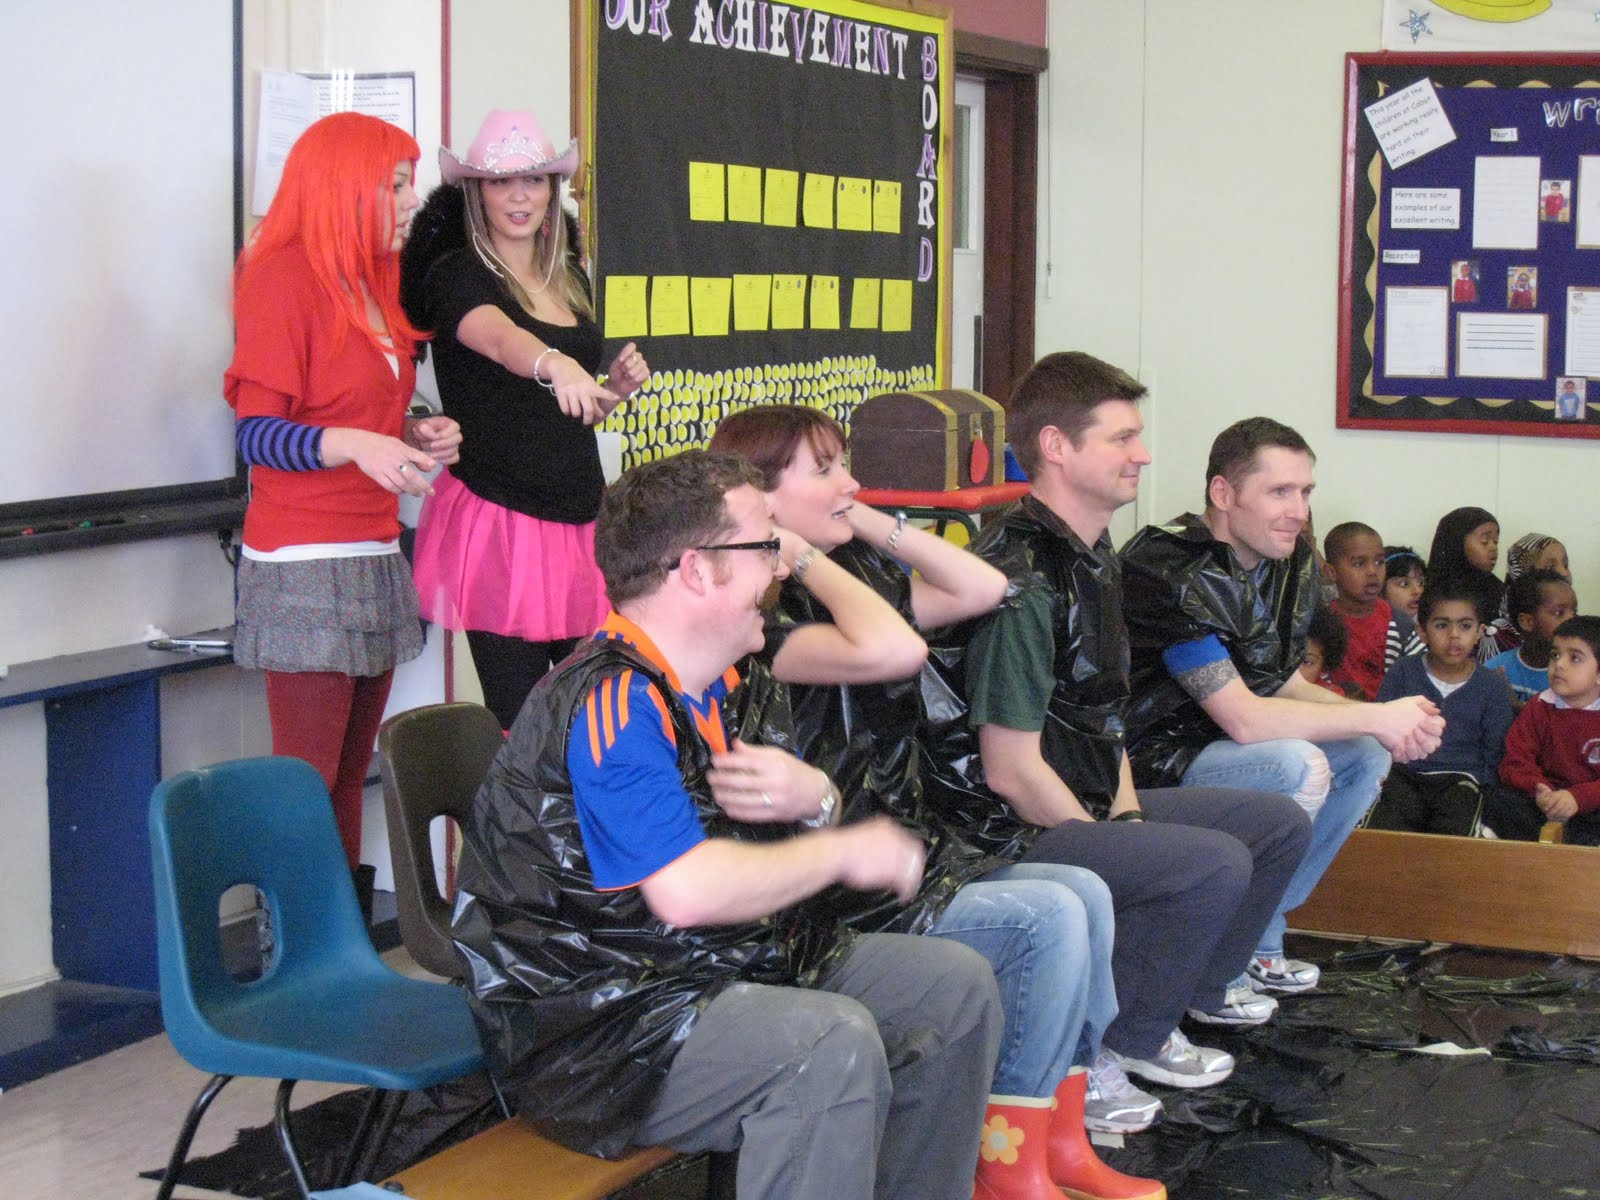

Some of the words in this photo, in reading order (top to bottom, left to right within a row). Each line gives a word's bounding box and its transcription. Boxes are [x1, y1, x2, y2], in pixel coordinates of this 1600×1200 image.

[604, 0, 673, 42] OUR
[689, 0, 908, 79] ACHIEVEMENT
[1386, 99, 1400, 111] year
[1402, 93, 1410, 101] all
[1411, 87, 1424, 95] the
[1375, 113, 1402, 128] children
[1380, 131, 1391, 140] are
[1392, 117, 1418, 132] working
[1419, 107, 1438, 119] really
[1386, 141, 1402, 151] hard
[1413, 127, 1429, 138] their
[917, 36, 938, 282] BOARD
